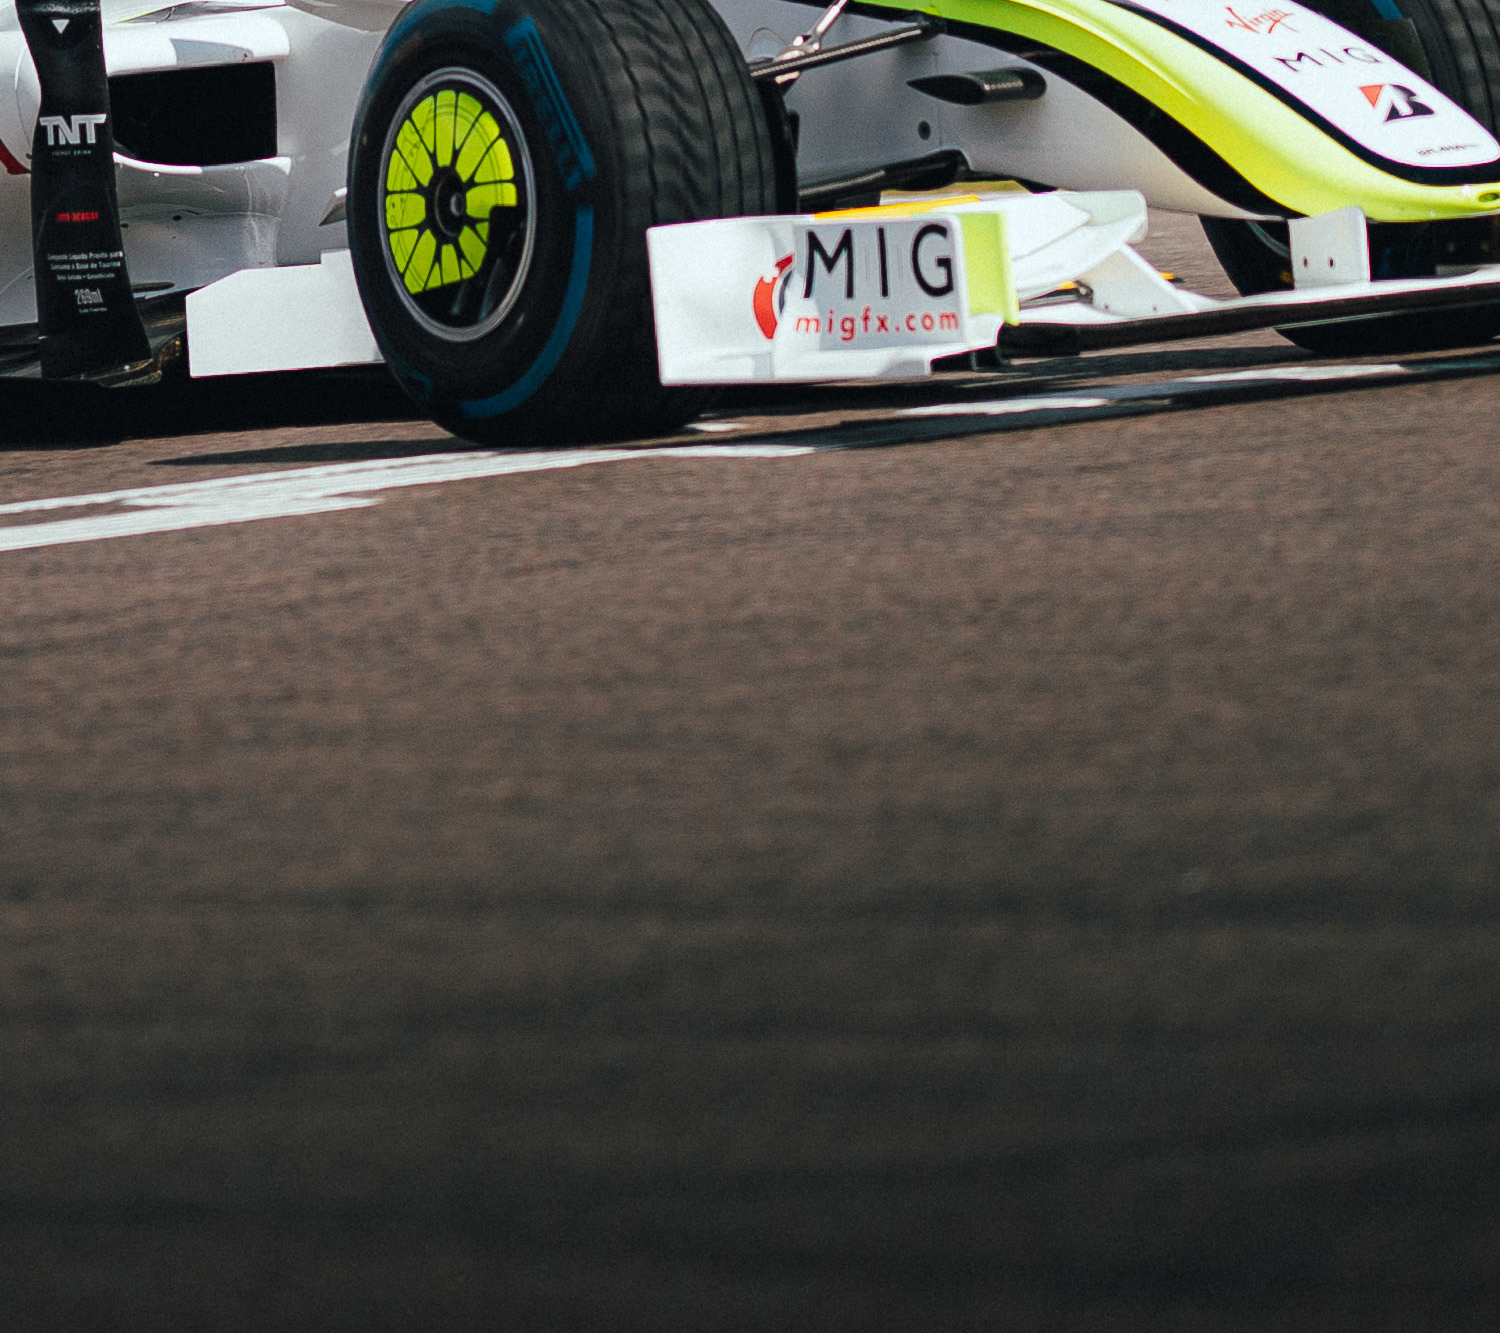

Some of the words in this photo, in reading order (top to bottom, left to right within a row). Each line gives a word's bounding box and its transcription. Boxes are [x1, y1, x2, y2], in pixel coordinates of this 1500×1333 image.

[1225, 6, 1299, 34] Virgin
[1274, 47, 1382, 72] MIG
[39, 114, 106, 146] TNT
[803, 223, 954, 299] MIG
[796, 305, 959, 342] migfx.com
